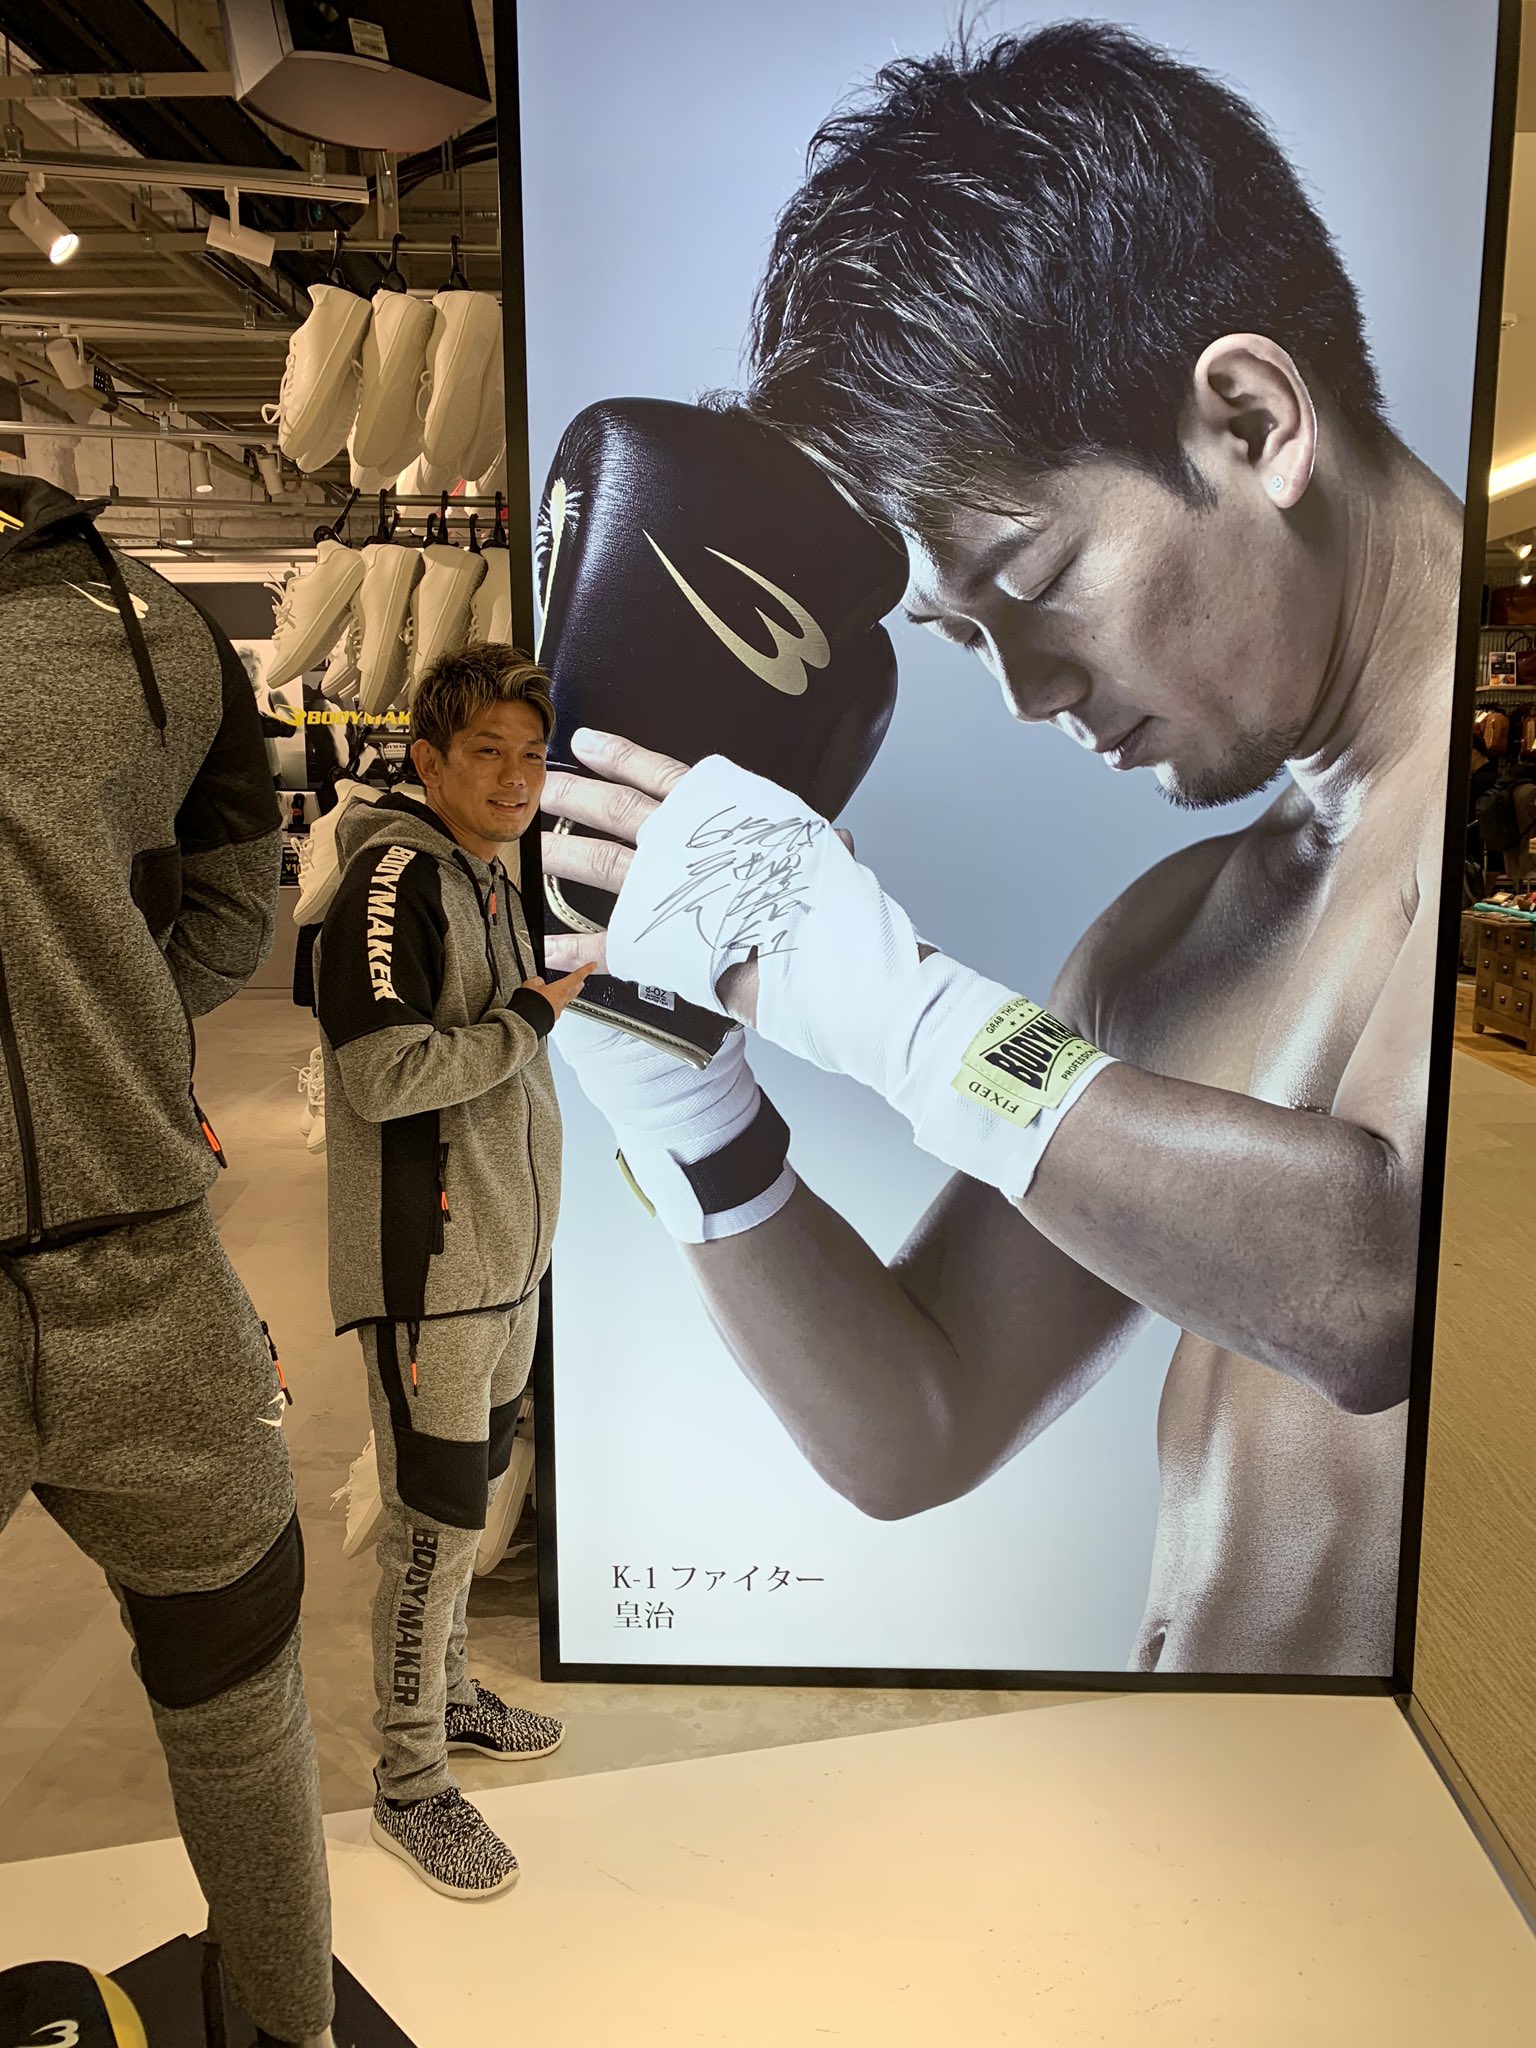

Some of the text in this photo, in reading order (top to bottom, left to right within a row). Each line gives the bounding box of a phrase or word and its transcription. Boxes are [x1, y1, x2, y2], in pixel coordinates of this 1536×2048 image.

[367, 845, 417, 1003] BODYMAKER
[985, 1015, 1005, 1034] GRAB
[1000, 1005, 1017, 1017] THE
[968, 1080, 1020, 1115] FIXED
[612, 1565, 825, 1592] K-1 ファイター
[393, 1528, 440, 1706] BODYMAKER
[613, 1600, 675, 1630] 皇治
